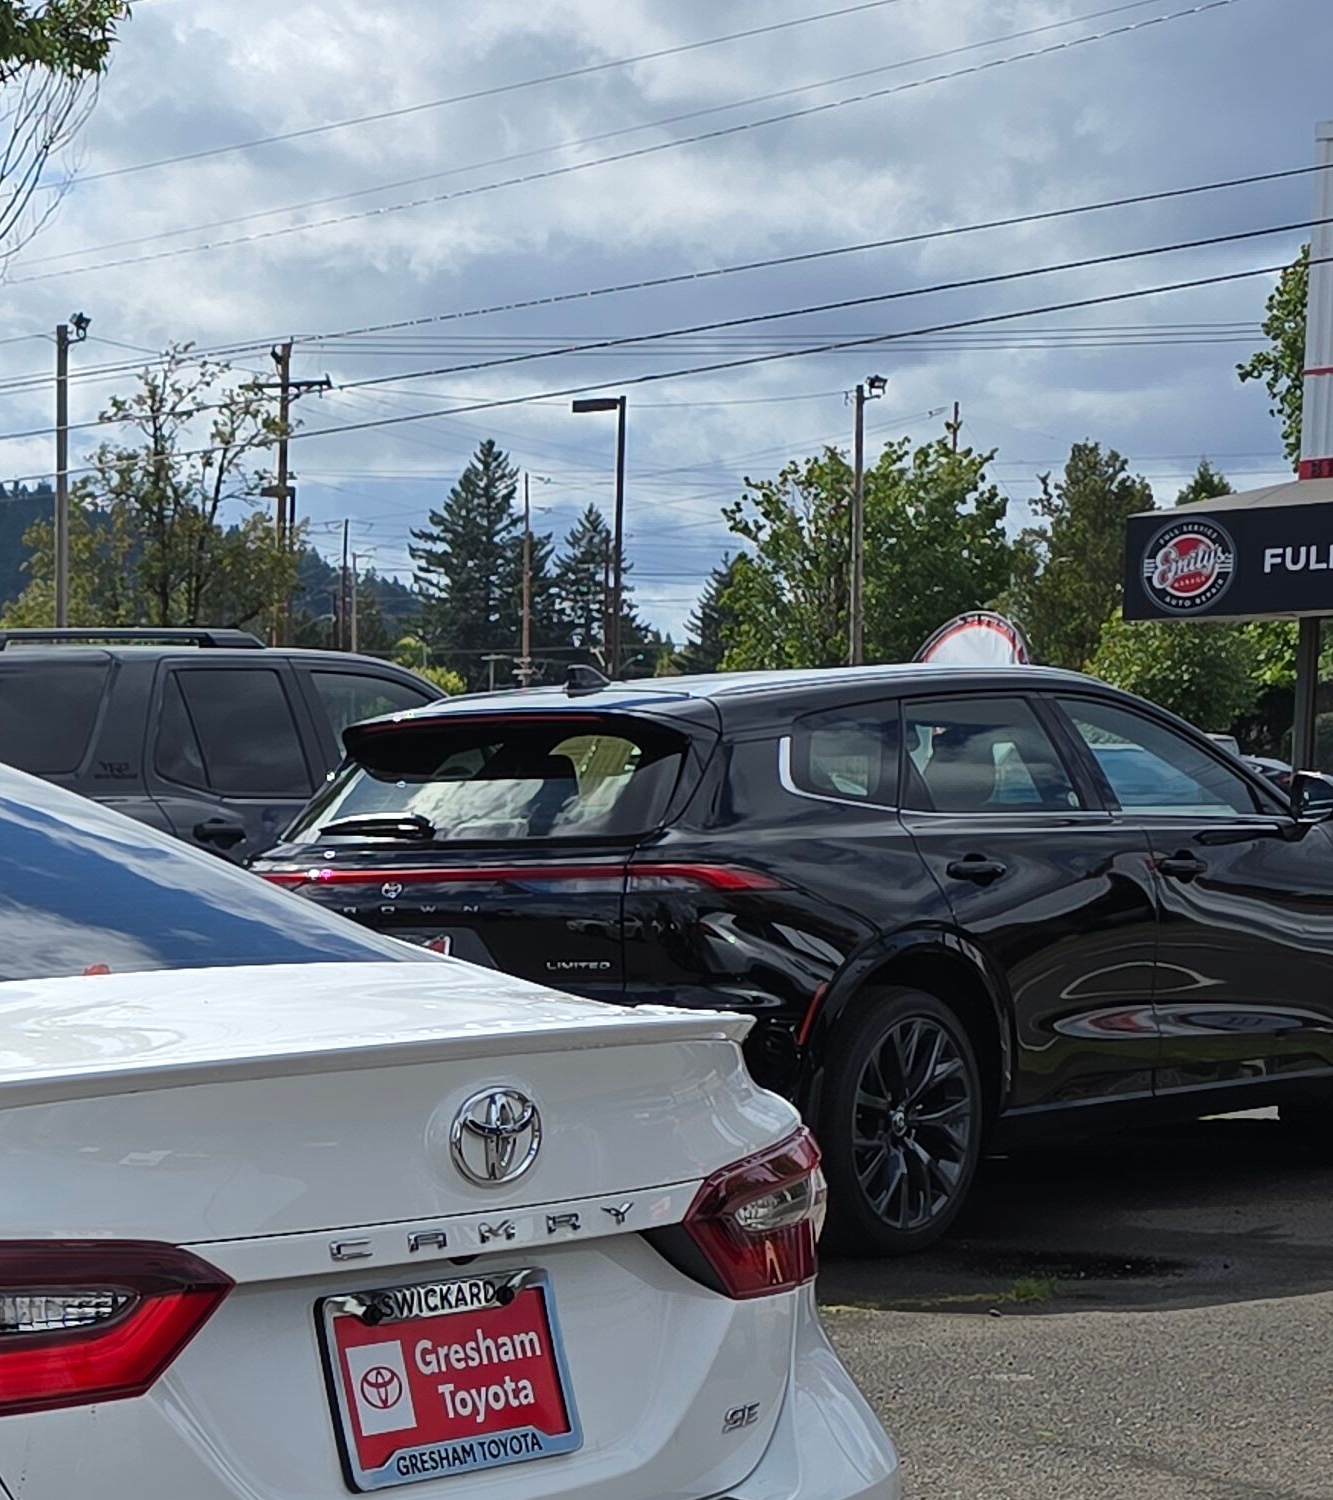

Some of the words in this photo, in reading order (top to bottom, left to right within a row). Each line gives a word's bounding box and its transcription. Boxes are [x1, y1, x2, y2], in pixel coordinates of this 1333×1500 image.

[1263, 544, 1333, 573] FUL
[342, 904, 480, 914] ROWN
[545, 960, 611, 970] LIMITED
[329, 1201, 634, 1261] CAMRY
[382, 1279, 497, 1318] SWICKARD
[414, 1328, 542, 1376] Gresham
[437, 1375, 536, 1424] Toyota
[396, 1442, 479, 1476] GRESHAM
[481, 1431, 544, 1462] TOYOTA
